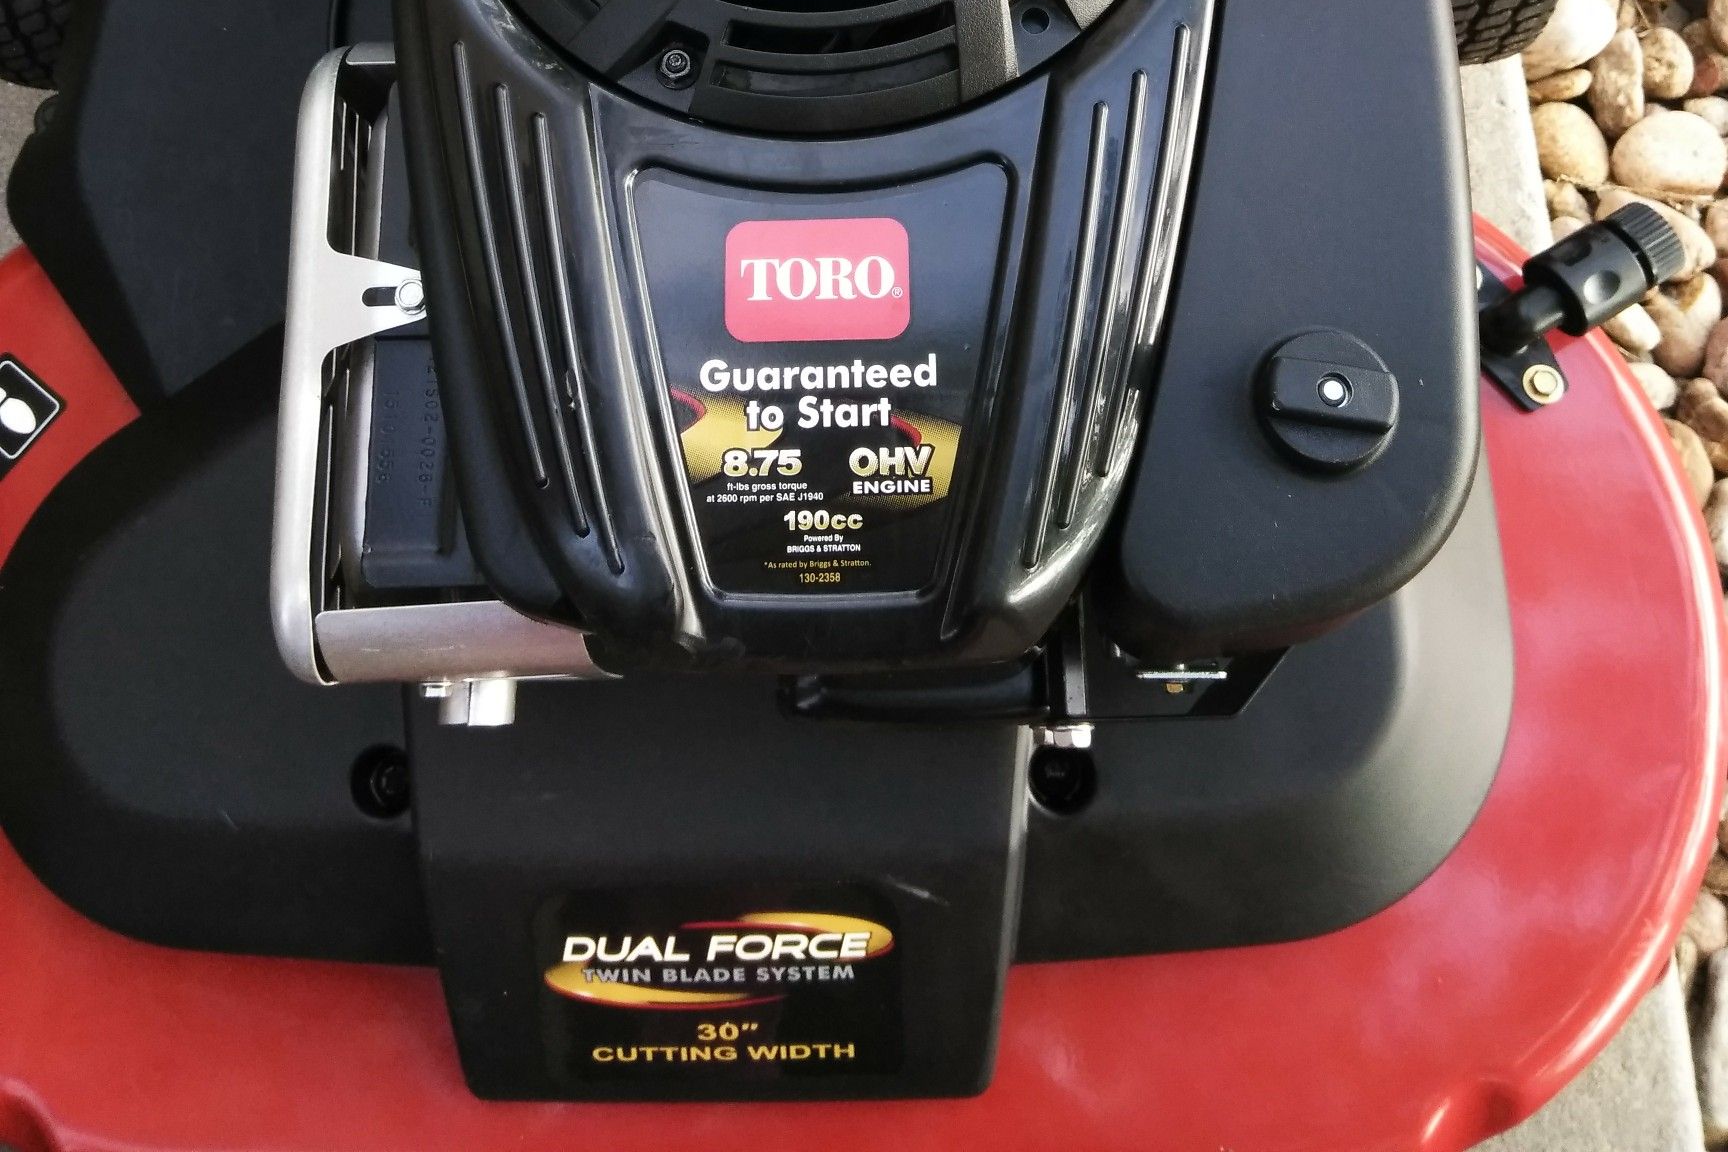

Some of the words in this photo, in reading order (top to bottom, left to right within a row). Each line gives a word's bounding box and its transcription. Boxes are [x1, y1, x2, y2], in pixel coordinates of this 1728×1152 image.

[700, 353, 938, 392] Guaranteed
[746, 400, 784, 430] to
[797, 396, 892, 430] Start
[723, 448, 803, 478] 8.75
[849, 446, 933, 478] OHV
[726, 482, 750, 491] ft-lbs
[751, 483, 777, 492] gross
[779, 482, 808, 492] torque
[852, 479, 931, 495] ENGINE
[706, 495, 715, 503] at
[739, 495, 758, 504] rpm
[759, 495, 774, 504] per
[776, 493, 796, 502] SAE
[797, 493, 824, 502] J1940
[783, 509, 864, 531] 190cc
[803, 534, 833, 543] Powered
[834, 534, 844, 543] By
[786, 545, 815, 554] BRIGGS
[816, 544, 822, 553] &
[823, 543, 861, 553] STRATTON
[778, 561, 798, 569] rated
[799, 560, 808, 570] by
[809, 560, 831, 570] Briggs
[832, 559, 839, 568] &
[799, 572, 841, 583] 130-2358
[562, 935, 691, 962] DUAL
[706, 932, 871, 961] FORCE
[582, 967, 651, 983] TWIN
[662, 967, 746, 983] BLADE
[756, 964, 856, 982] SYSTEM
[592, 1046, 738, 1062] CUTTING
[747, 1044, 856, 1061] WIDTH
